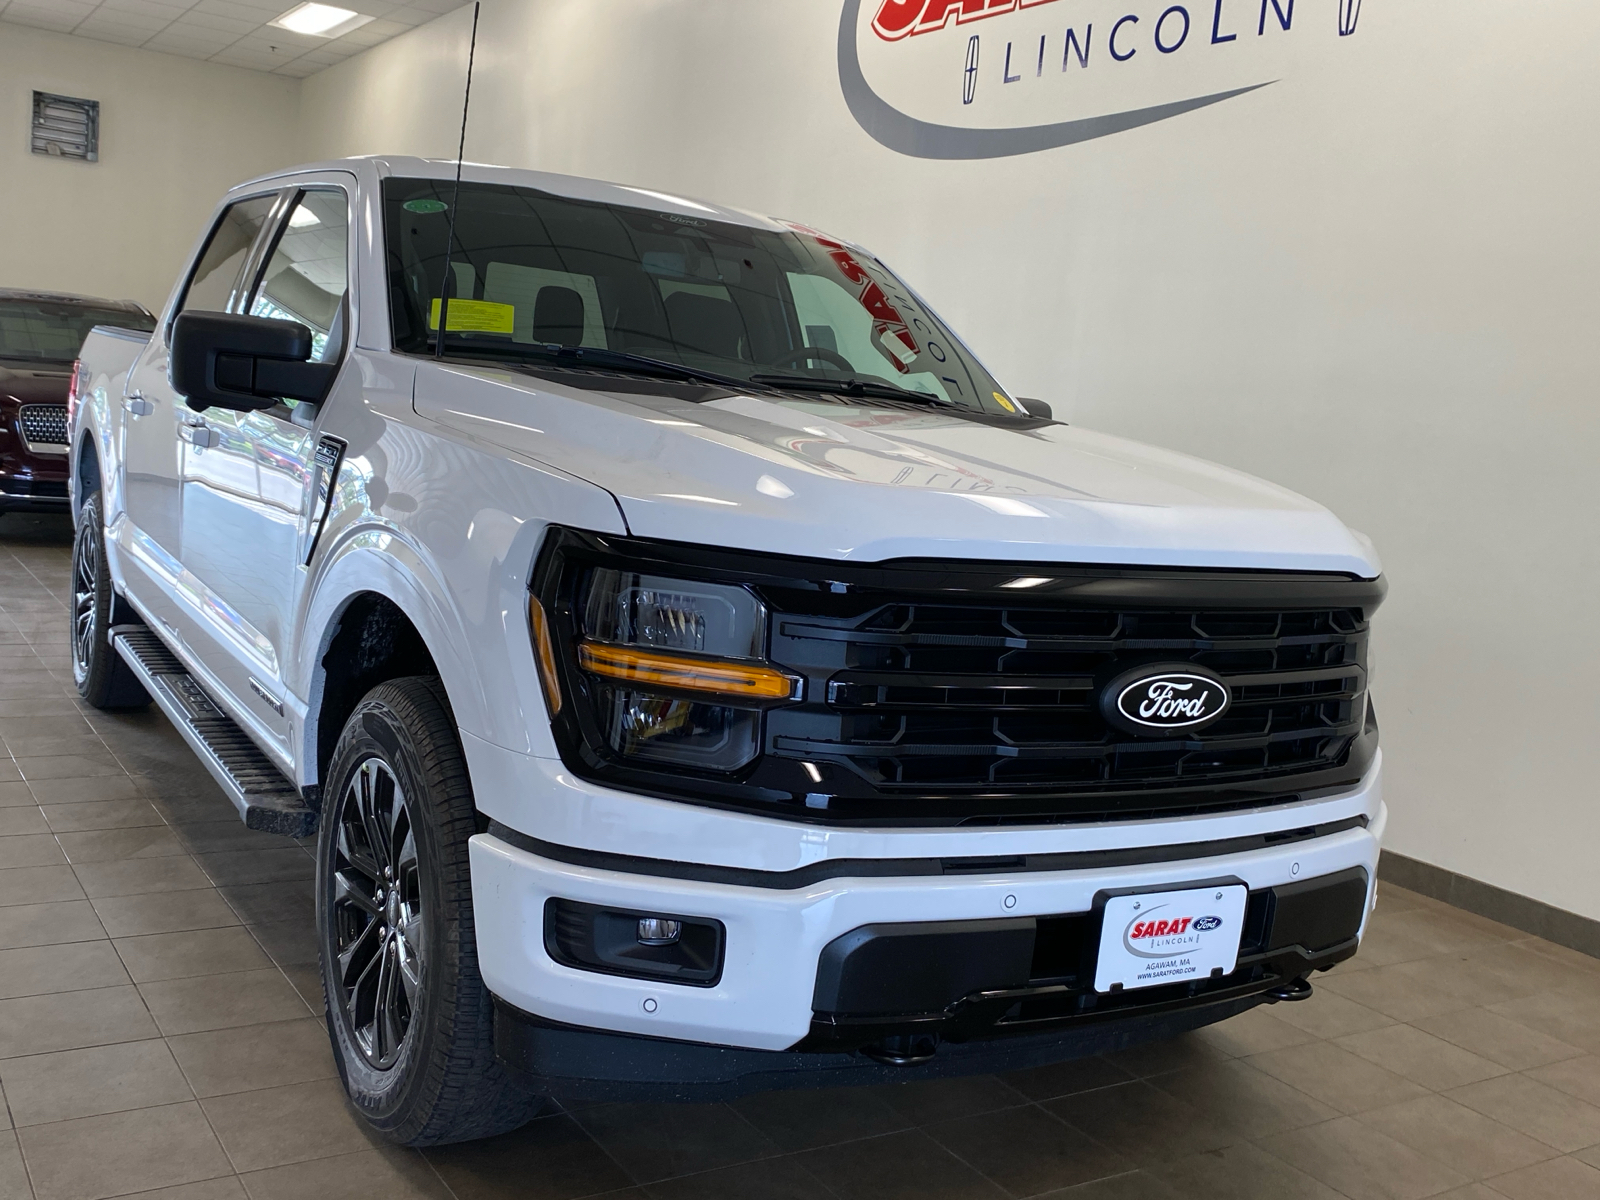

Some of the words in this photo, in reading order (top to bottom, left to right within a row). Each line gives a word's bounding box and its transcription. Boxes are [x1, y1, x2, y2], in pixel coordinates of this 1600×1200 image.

[1003, 0, 1294, 84] LINCOLN
[1139, 681, 1208, 718] Ford
[1130, 916, 1193, 939] SARAT
[1196, 917, 1218, 930] Ford
[1156, 936, 1194, 947] LINCOLN
[1137, 966, 1196, 980] WWW.SARATFORD.COM
[1145, 959, 1178, 971] AGAWAM,
[1179, 958, 1191, 967] MA
